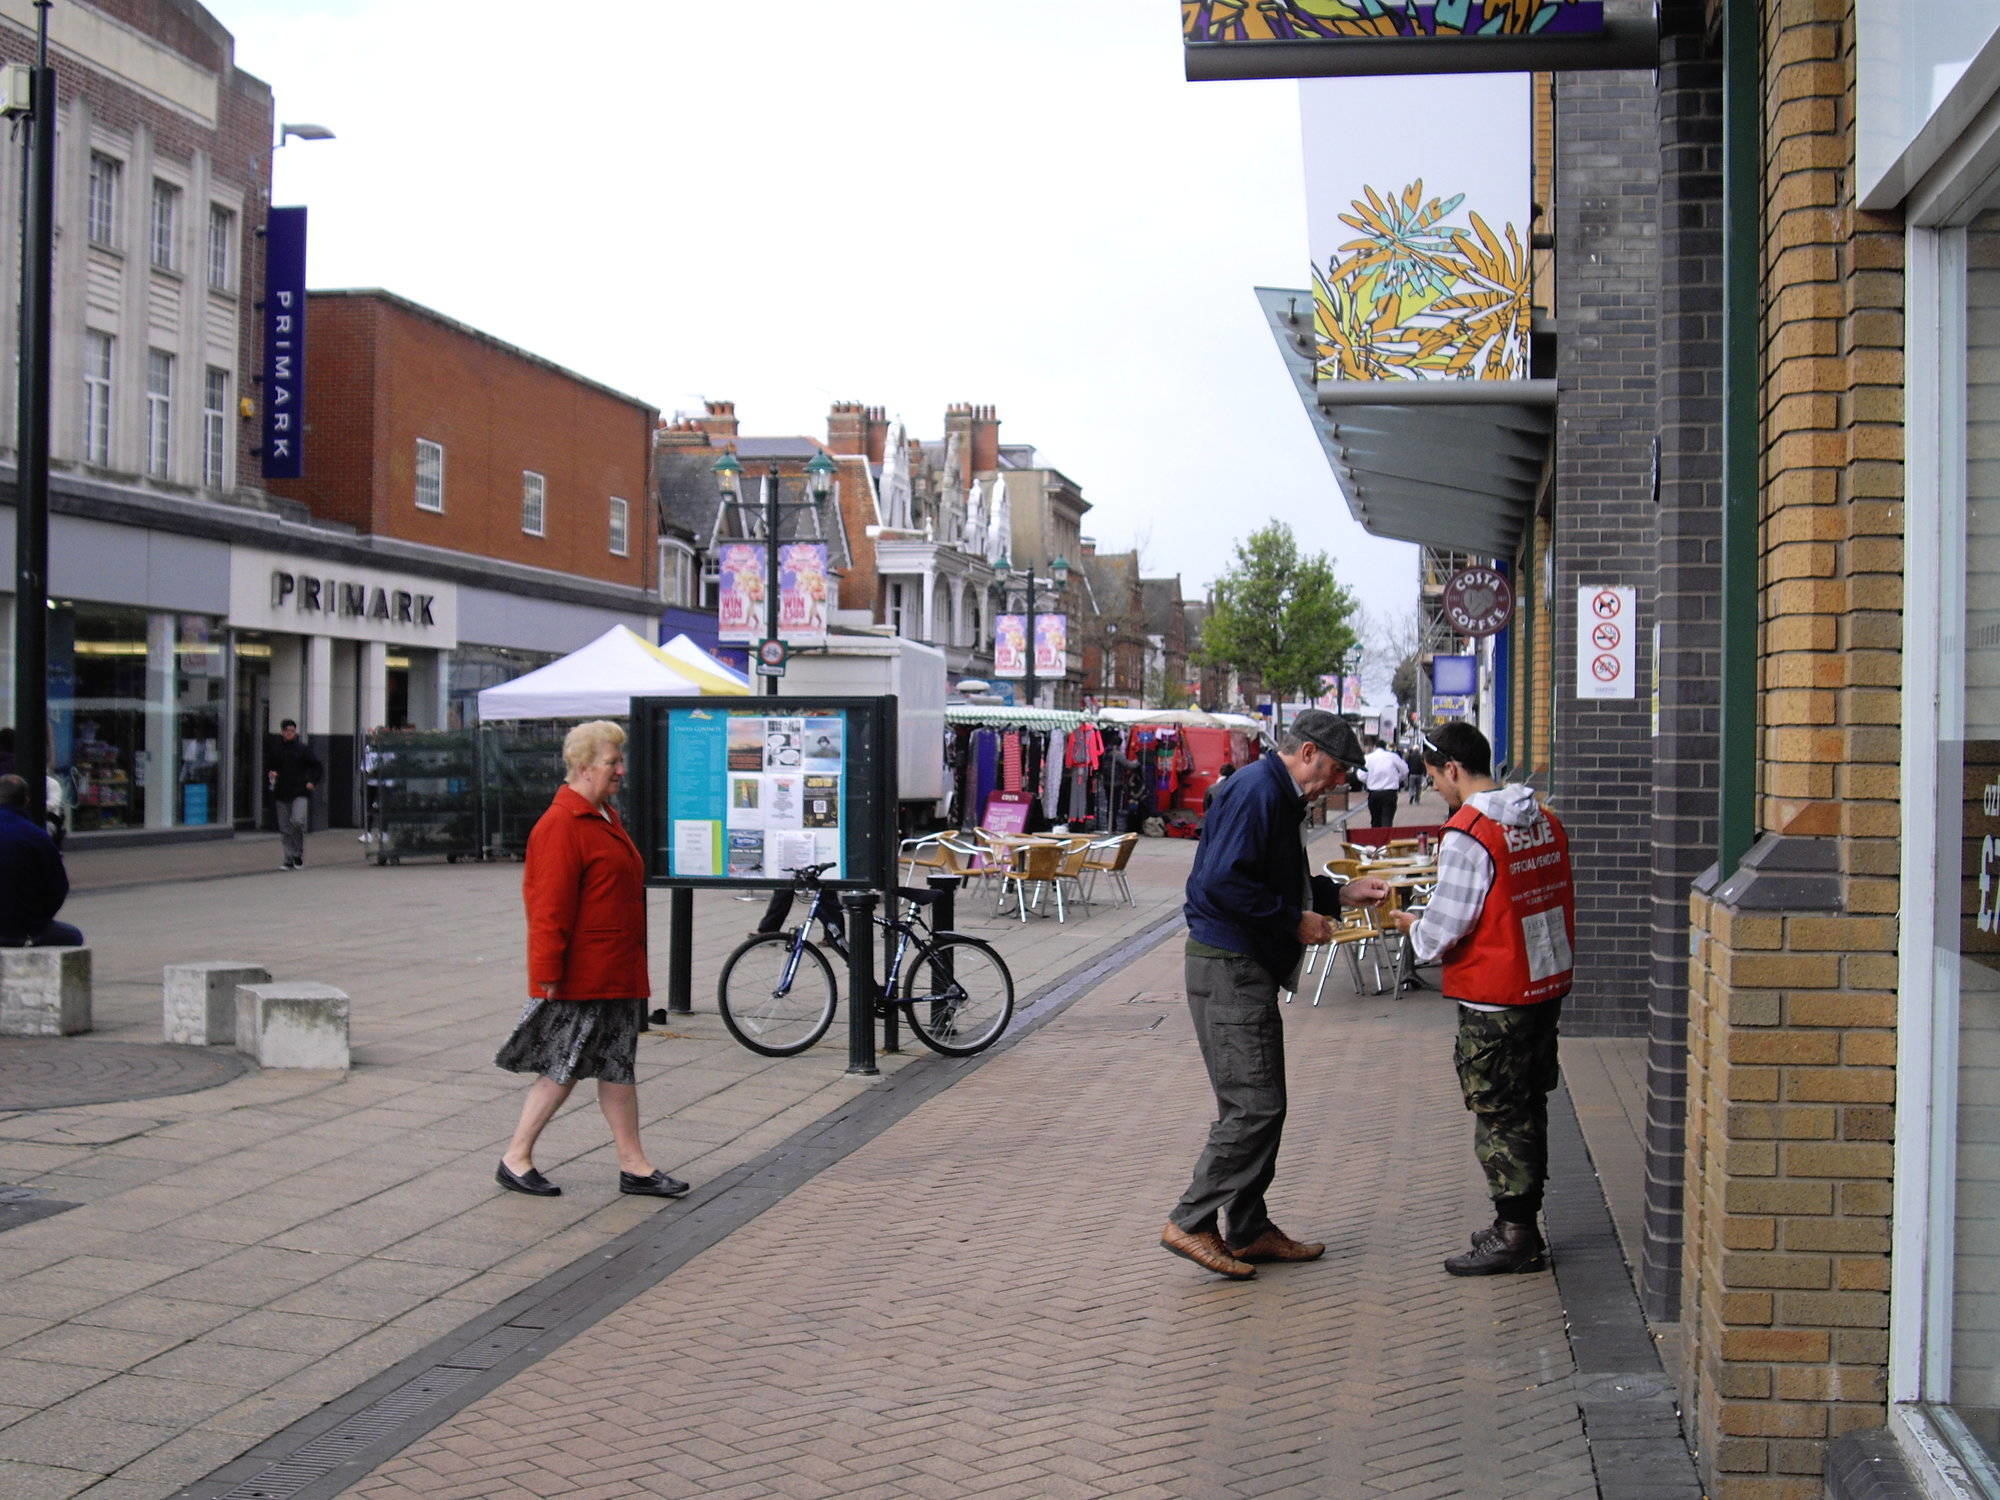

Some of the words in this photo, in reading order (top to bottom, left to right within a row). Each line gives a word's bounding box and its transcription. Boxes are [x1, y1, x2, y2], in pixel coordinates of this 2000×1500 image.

[273, 290, 292, 458] PRIMARK
[1456, 572, 1500, 592] COSTA
[271, 570, 435, 627] PRIMARK
[1452, 607, 1505, 630] COFFEE
[1503, 821, 1556, 854] ISSUE
[1509, 857, 1537, 875] OFFICIAL
[1536, 851, 1562, 868] VENDOR
